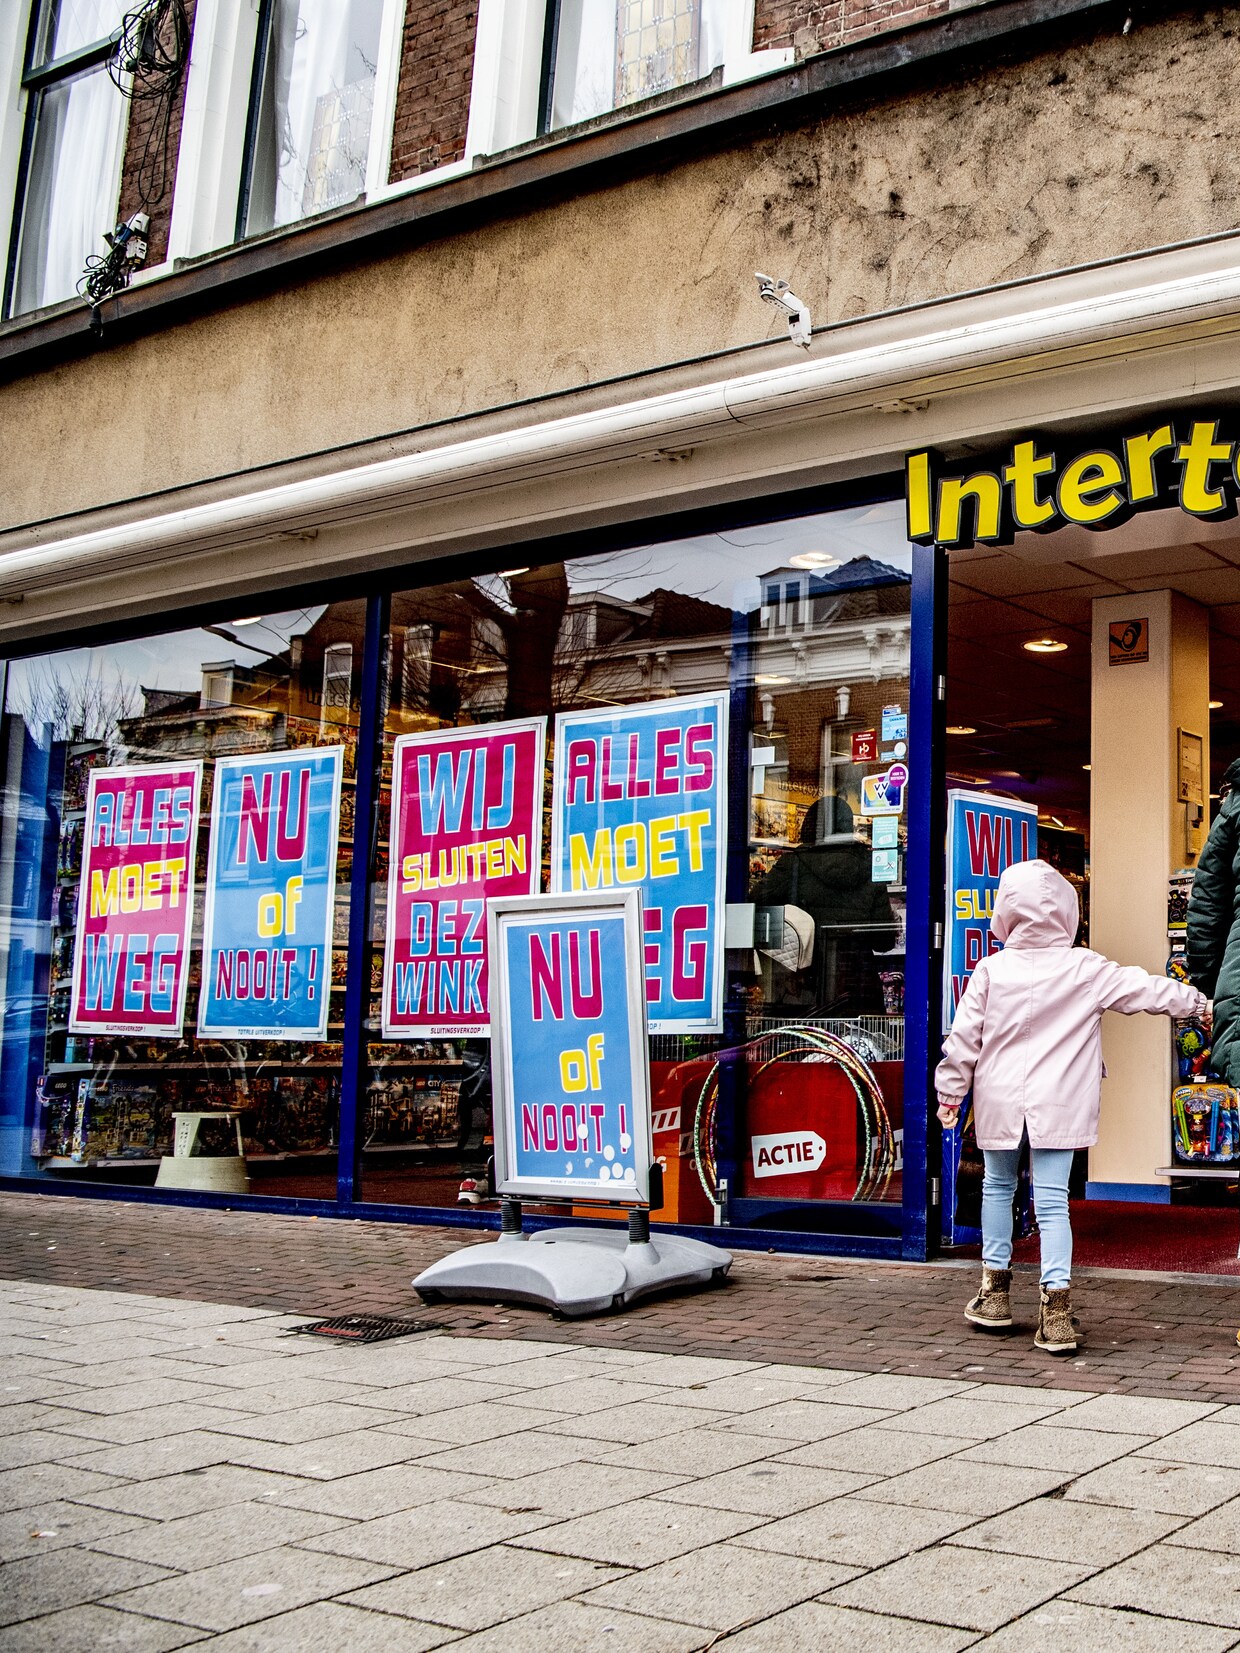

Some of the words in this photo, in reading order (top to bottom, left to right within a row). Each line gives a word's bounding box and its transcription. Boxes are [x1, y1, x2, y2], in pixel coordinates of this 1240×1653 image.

[417, 743, 516, 836] WIJ
[566, 723, 715, 806] ALLES
[92, 787, 192, 847] ALLES
[237, 769, 311, 865] NU
[402, 835, 526, 893] SLUITEN
[569, 809, 711, 891] MOET
[90, 858, 186, 918] MOET
[257, 875, 303, 939] of
[410, 898, 487, 957] DEZ
[644, 904, 708, 1003] EG
[84, 934, 179, 1012] WEG
[215, 948, 297, 1001] NOOIT
[308, 948, 318, 1001] !
[396, 958, 490, 1015] WINK
[528, 929, 604, 1022] NU
[559, 1033, 605, 1094] of
[521, 1103, 605, 1153] NOOIT
[757, 1141, 814, 1167] ACTIE
